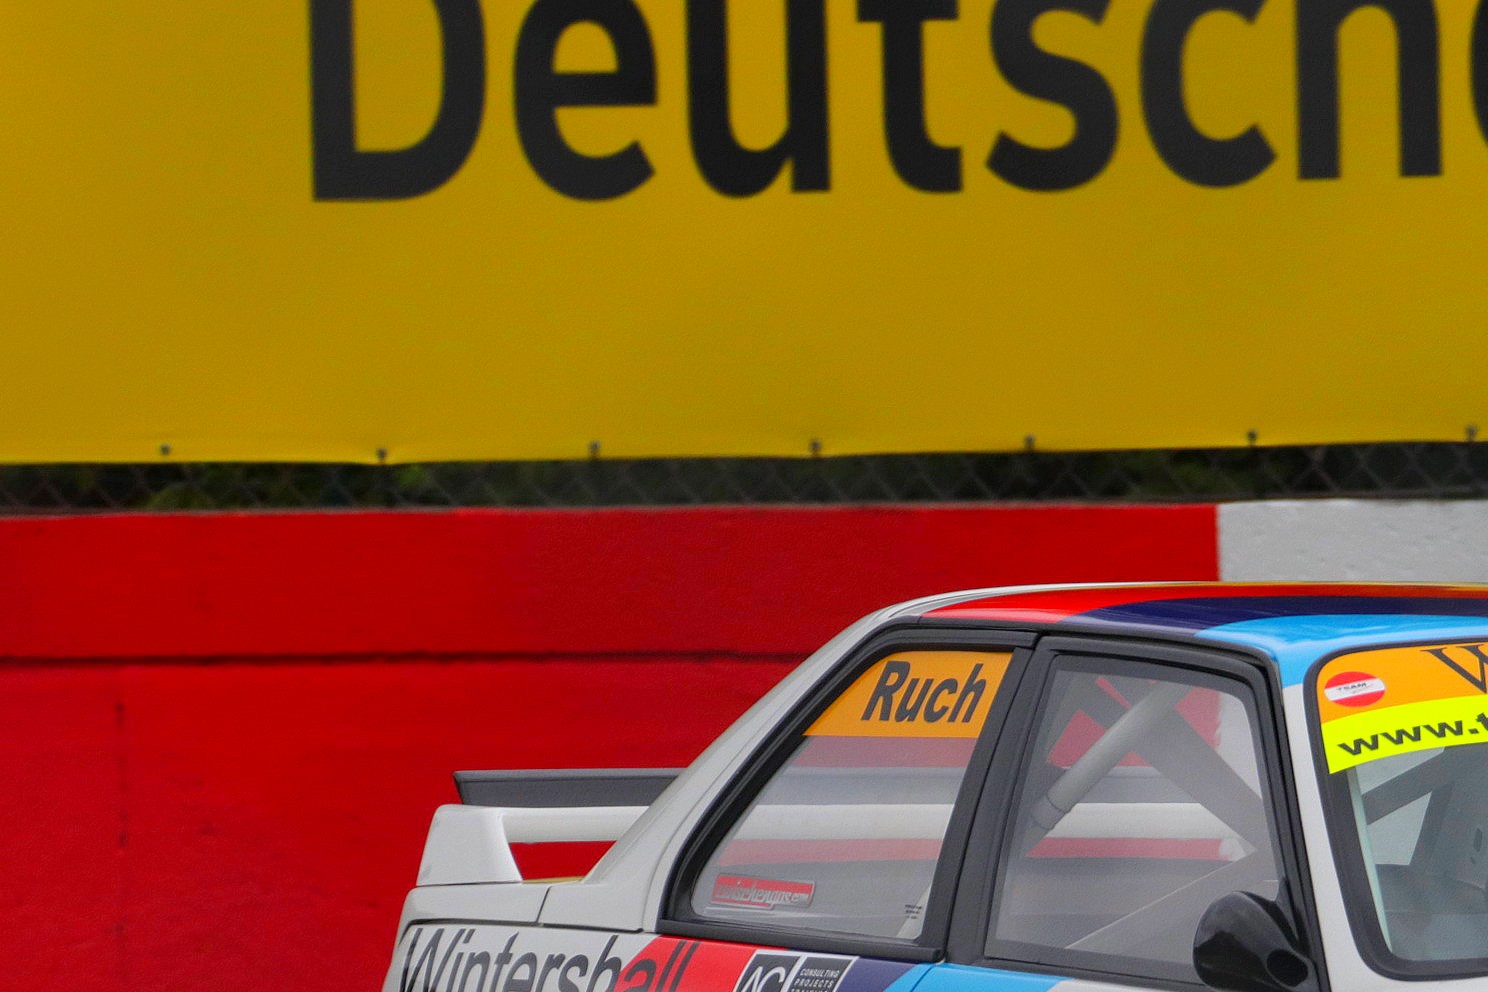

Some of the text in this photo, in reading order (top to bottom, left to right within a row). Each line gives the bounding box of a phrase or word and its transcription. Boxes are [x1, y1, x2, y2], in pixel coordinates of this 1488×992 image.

[860, 660, 987, 723] Ruch
[800, 968, 840, 978] CONSULTING
[794, 978, 834, 988] PROJECTS
